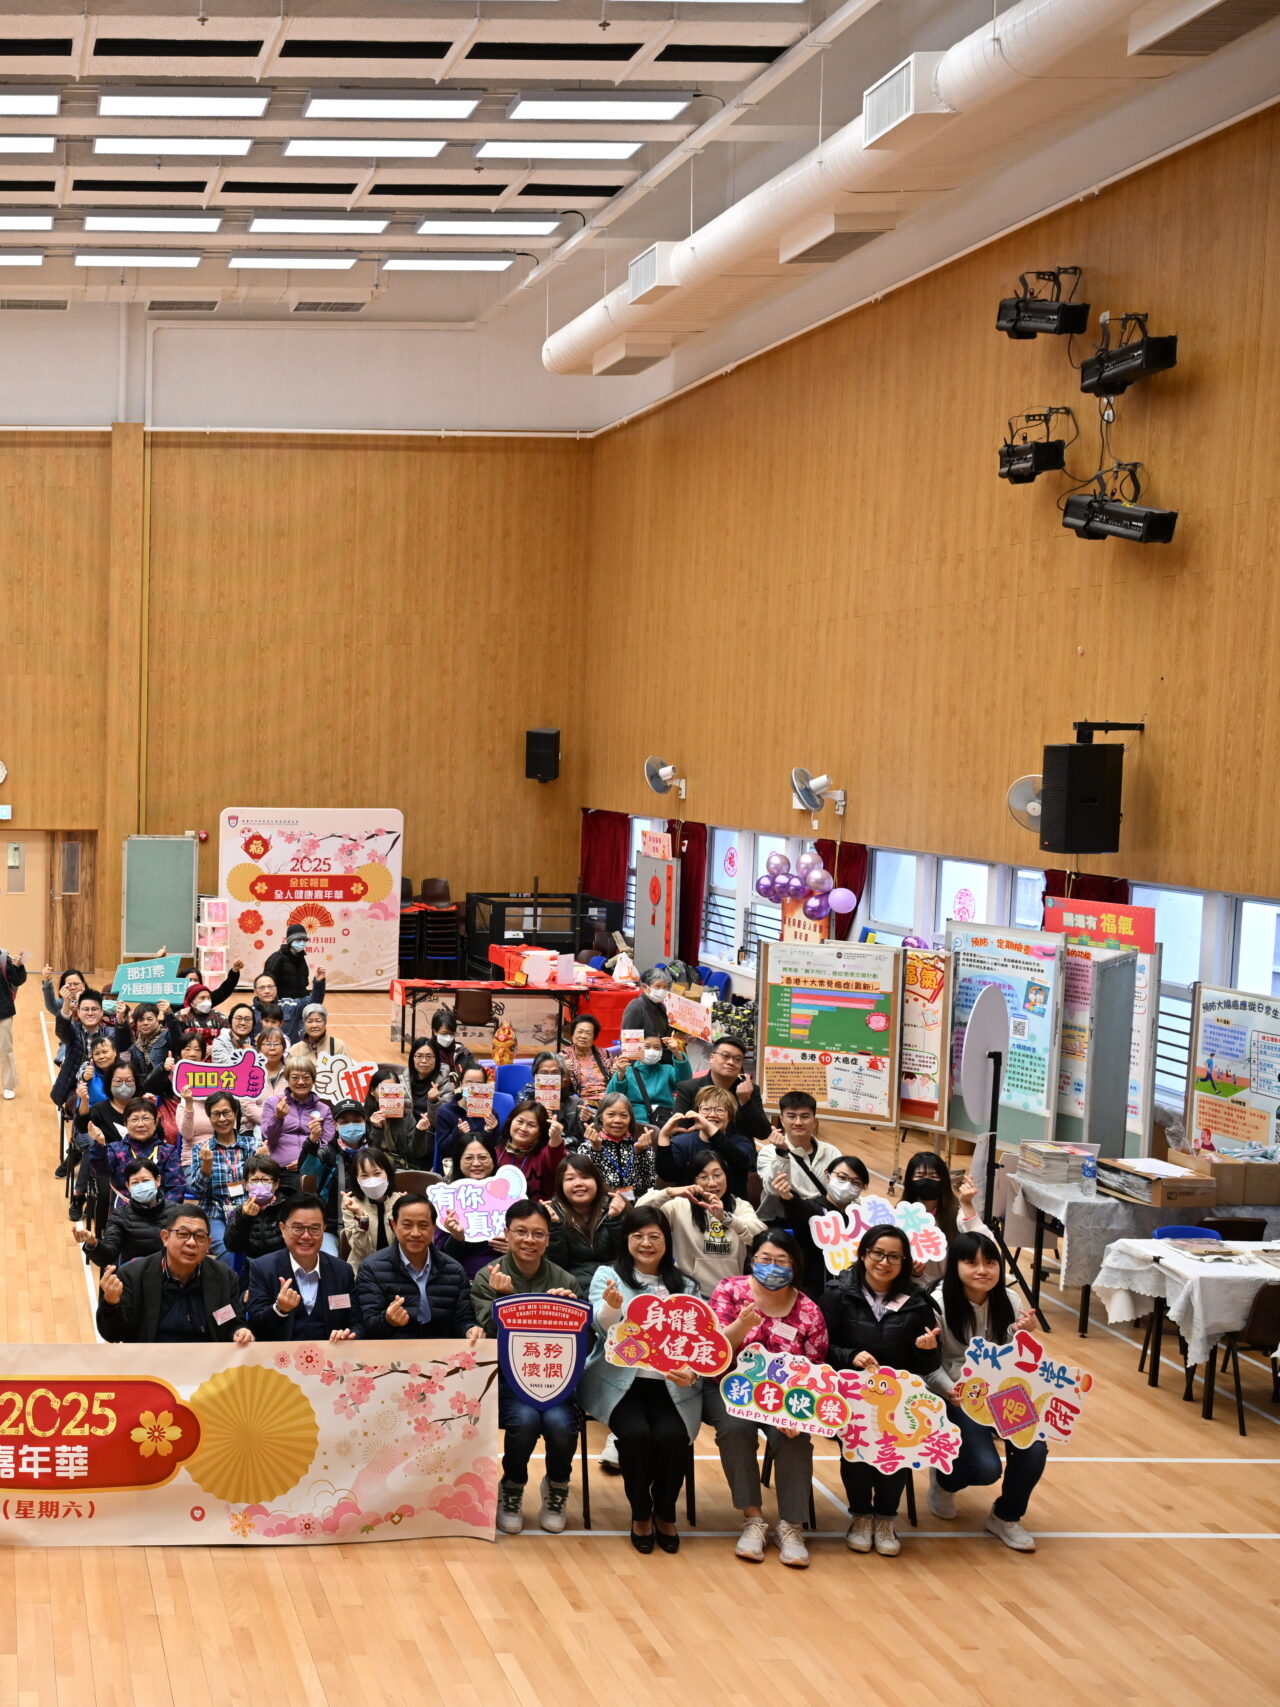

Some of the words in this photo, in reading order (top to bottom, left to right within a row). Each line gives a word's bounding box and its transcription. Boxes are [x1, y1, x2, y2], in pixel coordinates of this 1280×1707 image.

[289, 857, 331, 872] 2025
[274, 889, 344, 900] 全人健康嘉年華
[289, 877, 329, 888] 金蛇報喜
[1100, 913, 1135, 936] 福氣
[184, 1070, 237, 1090] 100分
[430, 1184, 485, 1211] 有你
[814, 1200, 929, 1247] 以人為本
[705, 1242, 731, 1254] MINIONS
[502, 1306, 517, 1314] ALICE
[640, 1301, 701, 1336] 身體
[658, 1334, 717, 1367] 健康
[967, 1331, 1081, 1436] 笑口常開
[727, 1377, 844, 1425] 新年快樂
[727, 1406, 770, 1425] HAPPY
[772, 1415, 798, 1429] NEW
[799, 1421, 836, 1436] YEAR
